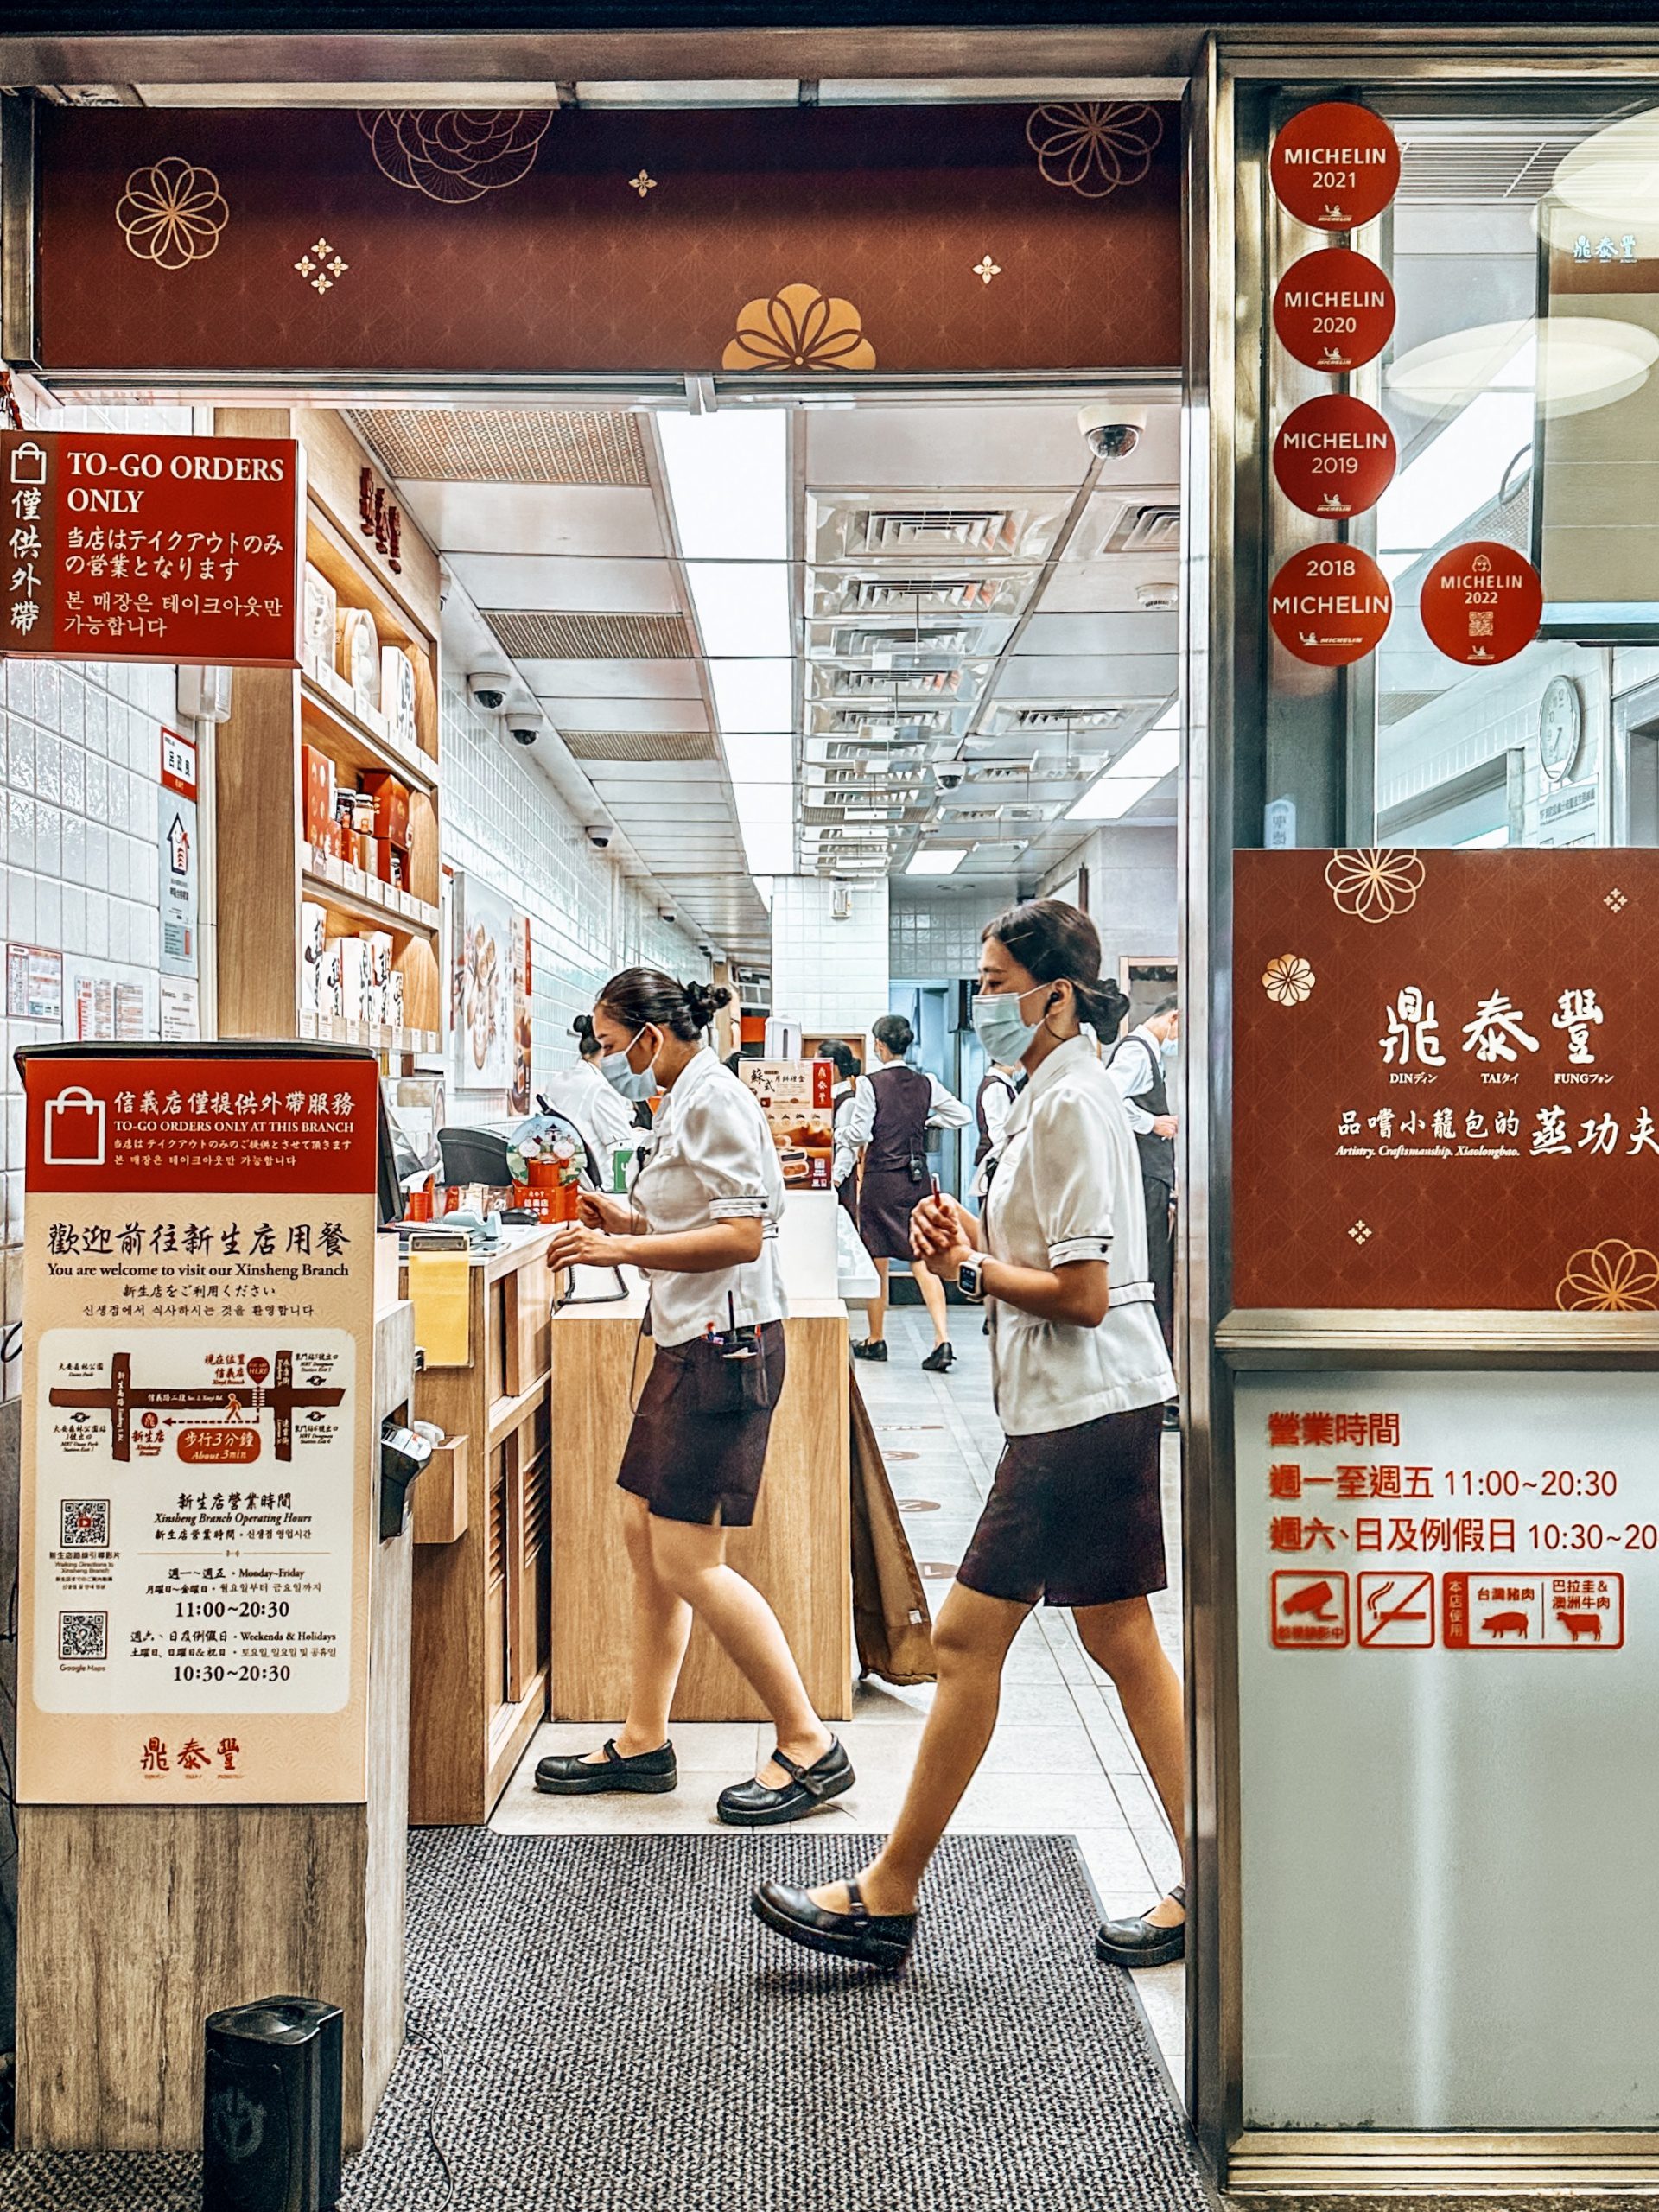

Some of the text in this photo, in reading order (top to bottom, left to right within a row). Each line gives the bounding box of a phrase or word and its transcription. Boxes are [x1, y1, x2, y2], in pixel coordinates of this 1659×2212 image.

[1284, 148, 1387, 165] MICHELIN
[1312, 172, 1357, 188] 2021
[1284, 291, 1385, 308] MICHELIN
[1313, 316, 1357, 334] 2020
[1283, 433, 1388, 449] MICHELIN
[67, 452, 284, 481] TO-GO ORDERS
[1312, 457, 1358, 474] 2019
[67, 487, 144, 513] ONLY
[67, 526, 283, 556] 当店はテイクアウトのみ
[9, 487, 42, 636] 僅供外帶
[65, 553, 240, 582] の営業となります
[1306, 560, 1356, 576] 2018
[1440, 575, 1522, 588] MICHELIN
[65, 592, 283, 617] 본 매장은 테이크아웃만
[1272, 596, 1389, 614] MICHELIN
[1465, 592, 1498, 605] 2022
[64, 615, 167, 638] 가능합니다
[1379, 986, 1604, 1067] 鼎泰豐
[113, 1090, 356, 1116] 信義店僅提供外帶服務
[114, 1121, 354, 1133] TO-GO ORDERS ONLY AT THIS BRANCH
[114, 1155, 124, 1165] 본
[1335, 1145, 1521, 1160] Artistry. Craftsmanship. Xiaolongbao.
[46, 1221, 351, 1258] 歡迎前往新生店用餐
[48, 1262, 349, 1280] You are welcome to visit our Xinsheng Branch
[123, 1284, 276, 1298] 新生店をご利用ください
[83, 1304, 145, 1318] 신생점에서
[131, 1430, 165, 1444] 新生店
[1268, 1411, 1401, 1448] 營業時間
[184, 1431, 254, 1447] 步行3分鐘
[191, 1452, 219, 1460] About
[1268, 1465, 1618, 1500] 週一至週五 11:00~20:30
[177, 1492, 292, 1510] 新生店營業時間
[154, 1513, 312, 1526] Xinsheng Branch Operating Hours
[1269, 1516, 1658, 1553] 週六、日及例假日 10:30~20
[175, 1601, 289, 1618] 11:00~20:30
[1552, 1596, 1611, 1610] 澳洲牛肉
[240, 1631, 283, 1641] Weekends
[286, 1631, 295, 1641] &
[298, 1631, 336, 1643] Holidays
[60, 1664, 105, 1673] Google Maps
[173, 1665, 290, 1681] 10:30~20:30
[140, 1736, 240, 1771] 鼎泰豐
